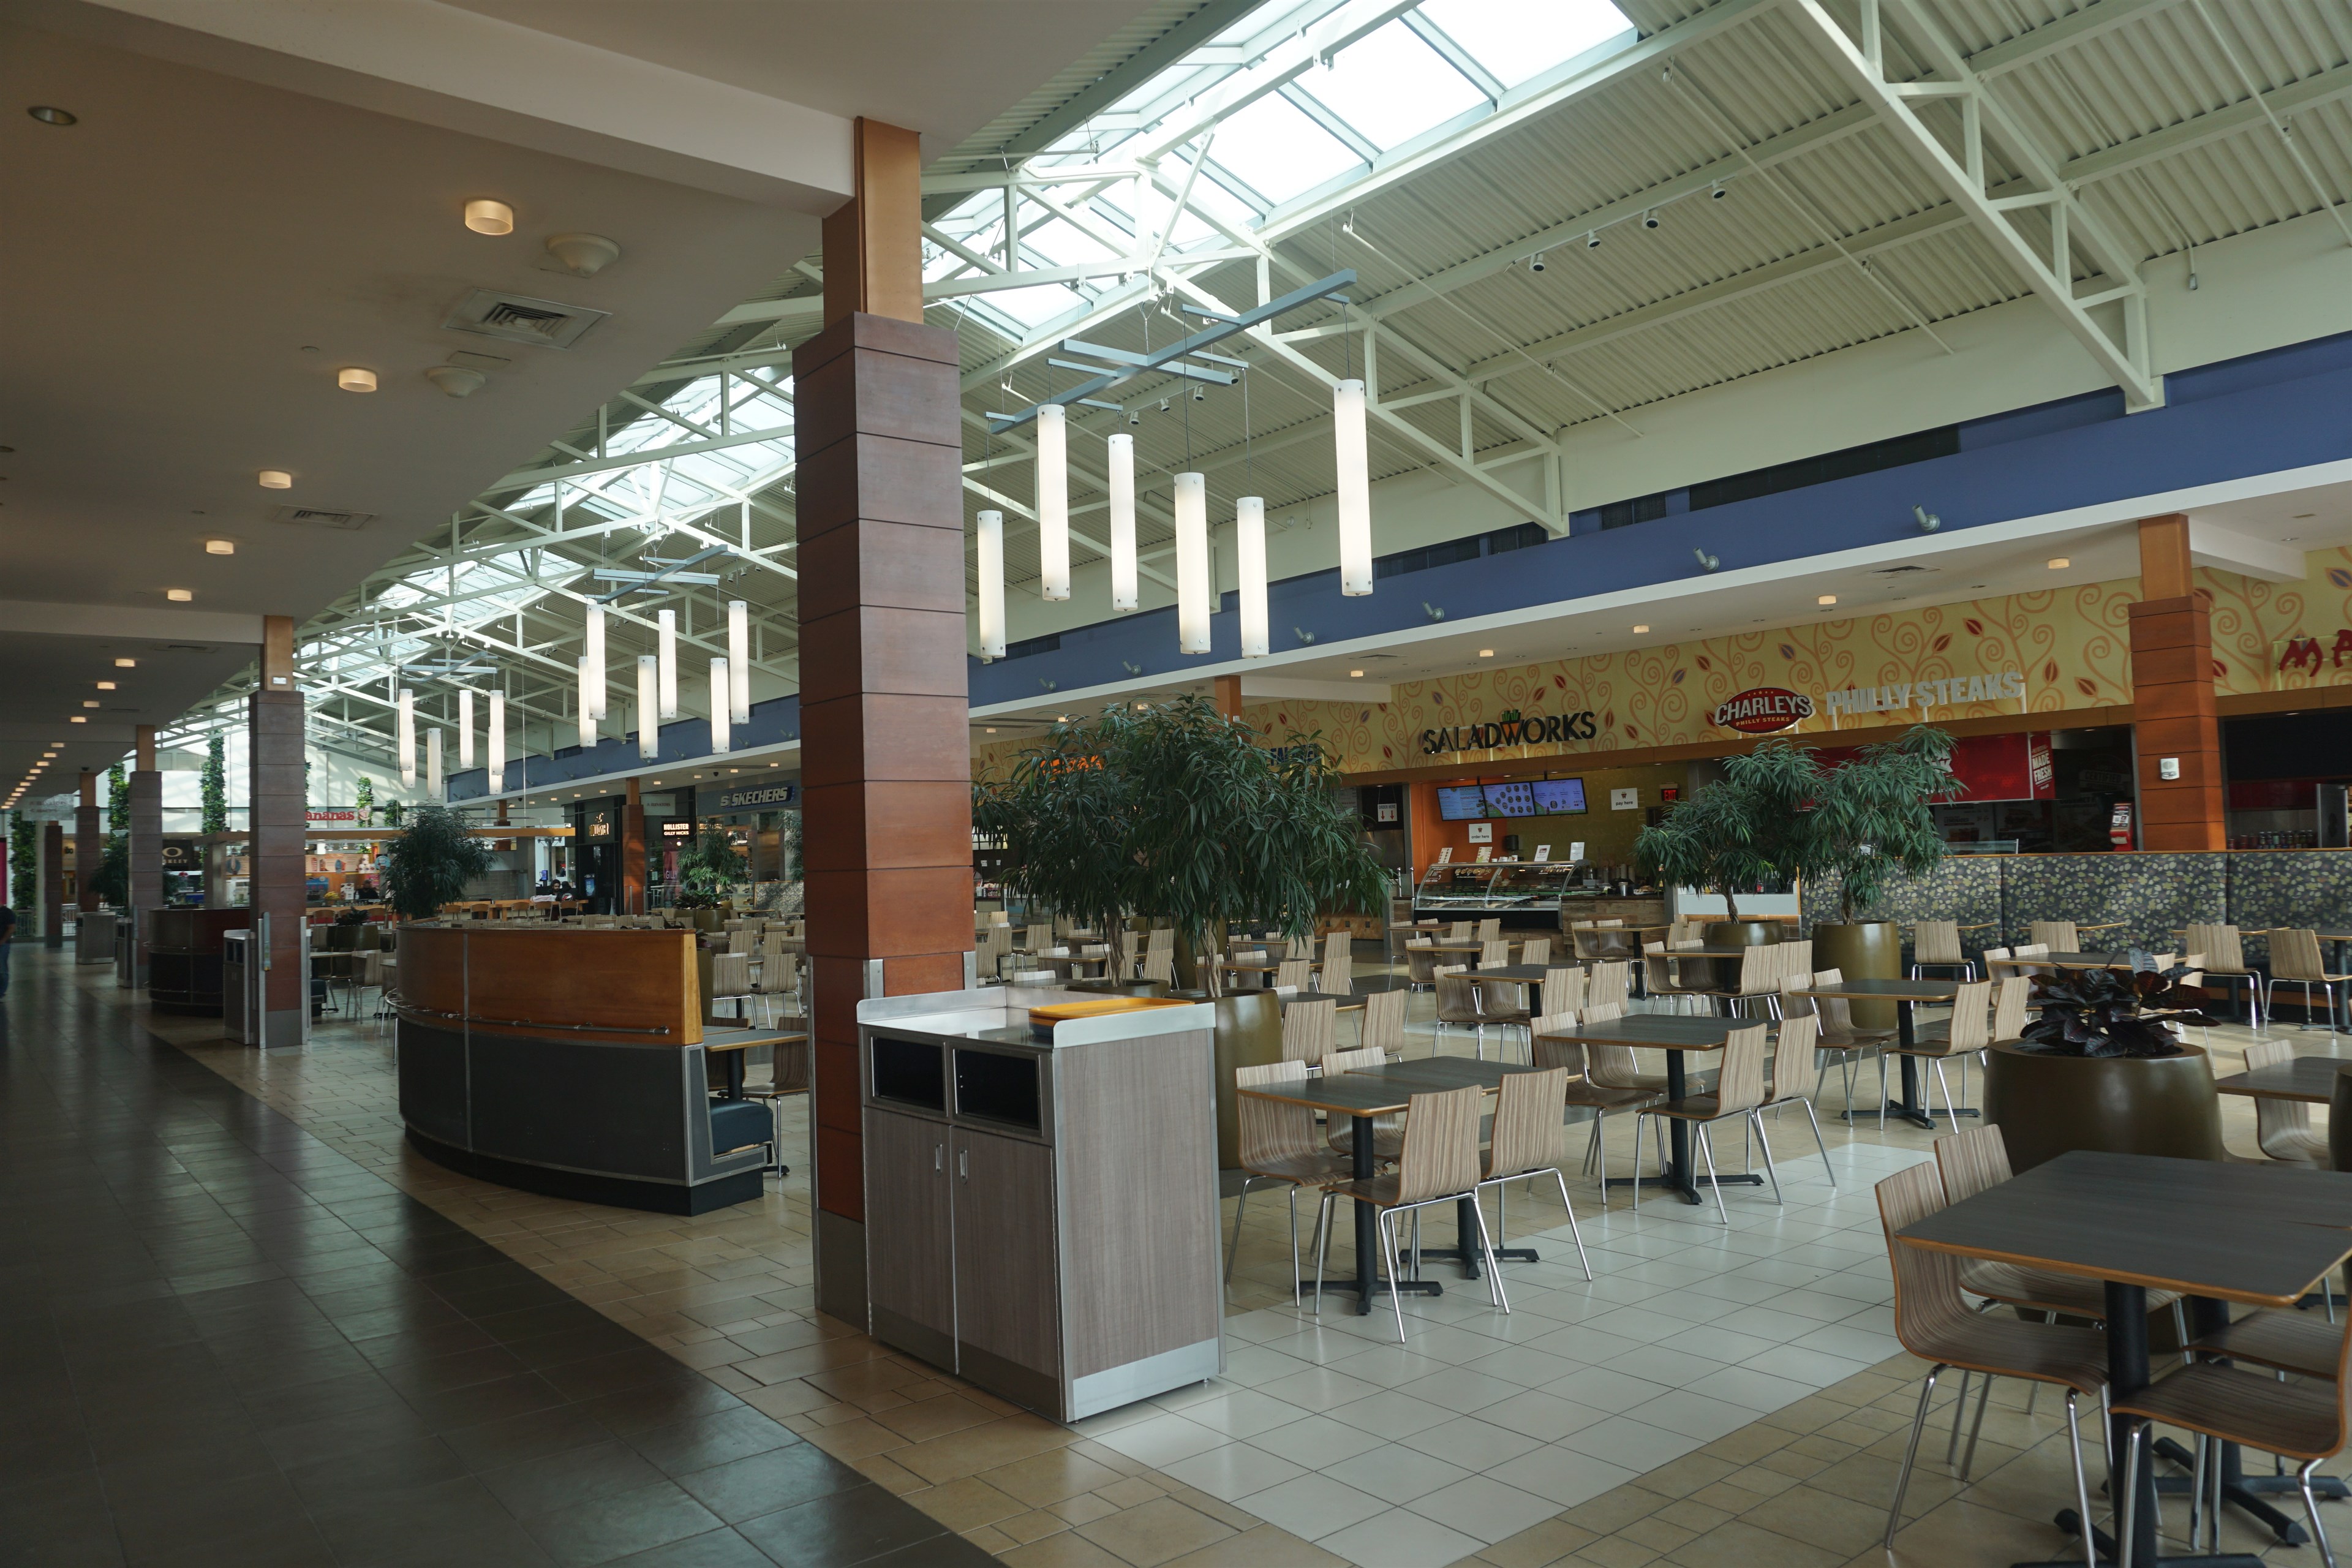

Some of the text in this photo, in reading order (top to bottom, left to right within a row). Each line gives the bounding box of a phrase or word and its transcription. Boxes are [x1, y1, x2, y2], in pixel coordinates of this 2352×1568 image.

[1826, 671, 2024, 715] PHILLY STEAKS
[1715, 696, 1812, 724] CHARLEYS
[1423, 710, 1597, 755] SALADWORKS
[2032, 752, 2050, 770] MADE
[2034, 764, 2052, 782] FRESH
[731, 787, 788, 806] SKECHERS
[1664, 790, 1676, 801] EXIT
[304, 811, 355, 820] ananas
